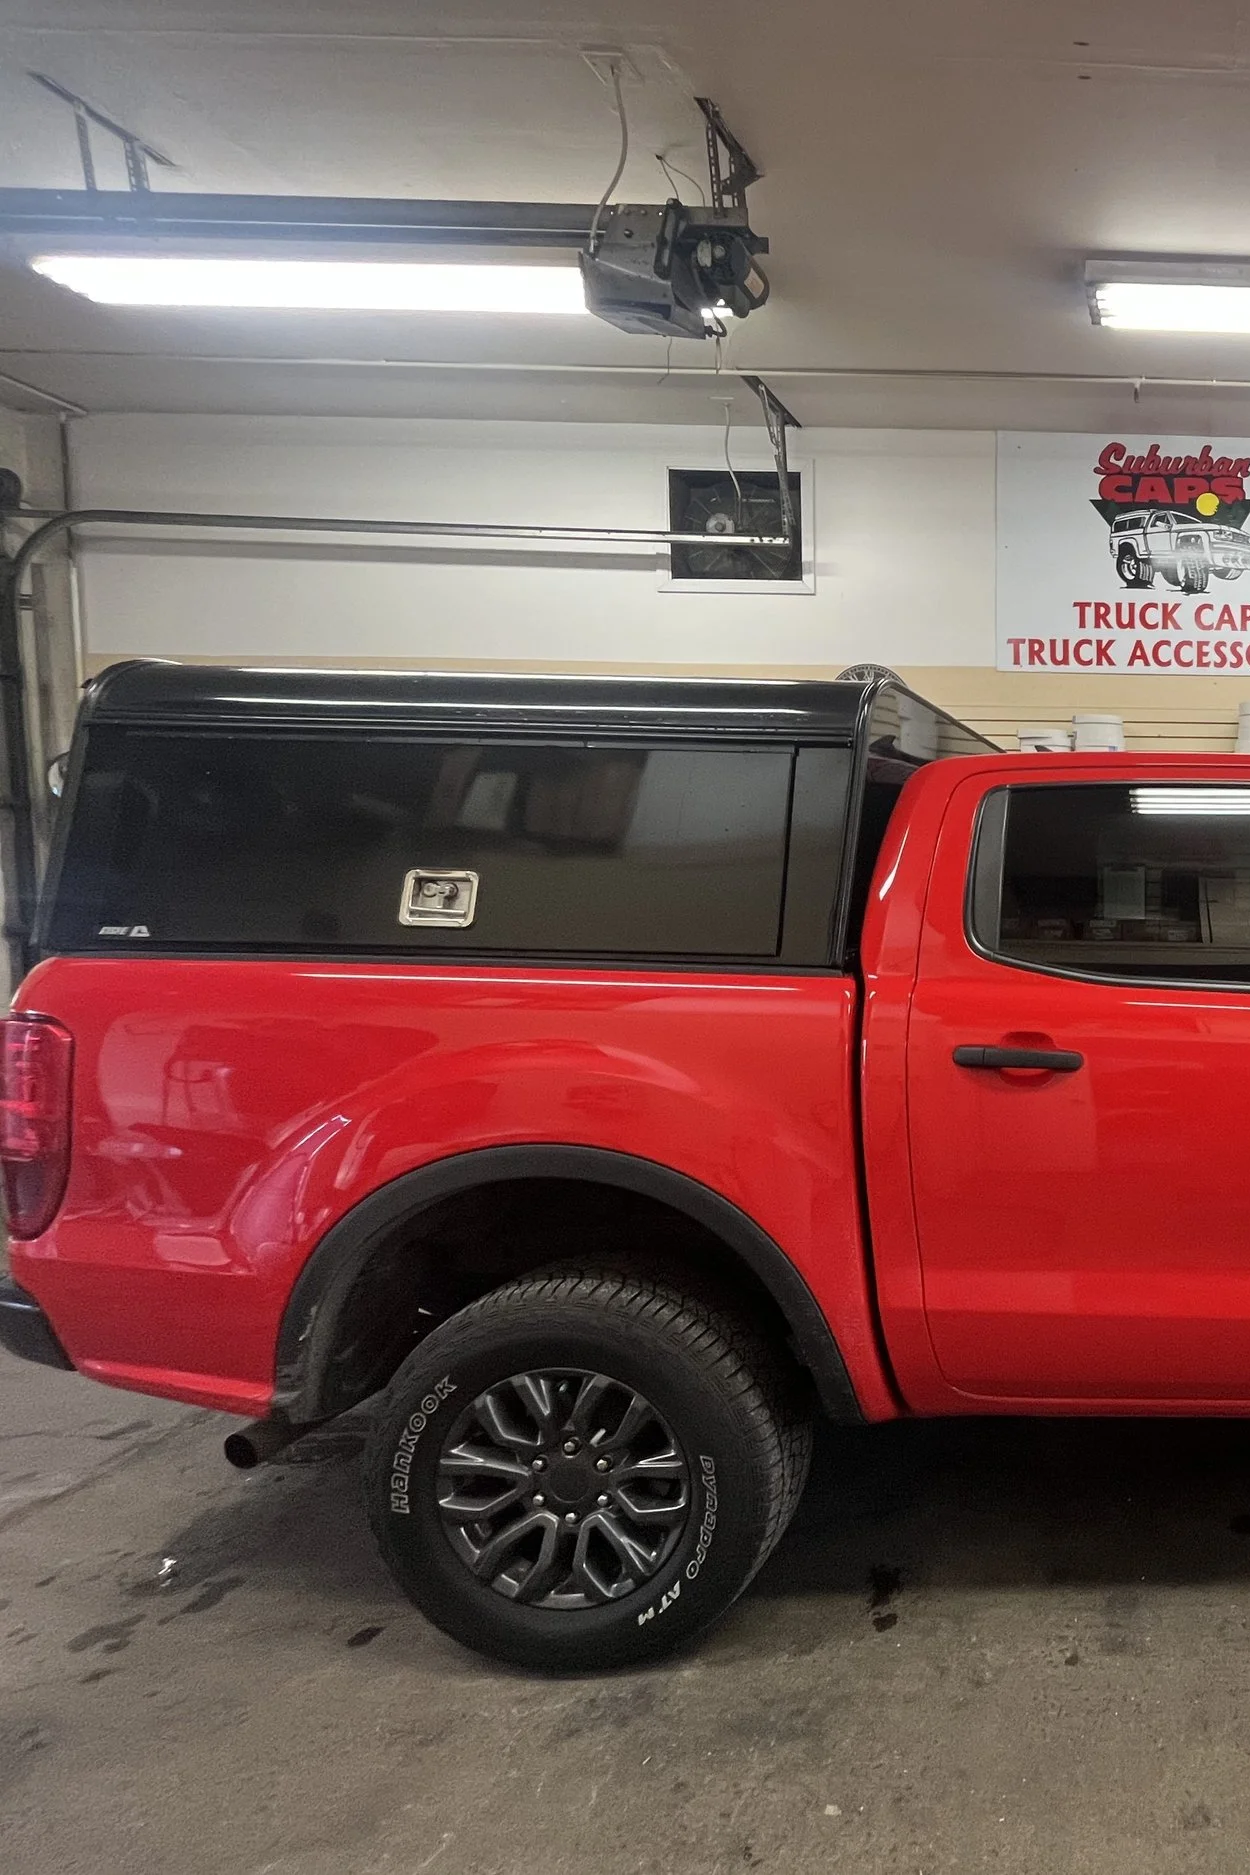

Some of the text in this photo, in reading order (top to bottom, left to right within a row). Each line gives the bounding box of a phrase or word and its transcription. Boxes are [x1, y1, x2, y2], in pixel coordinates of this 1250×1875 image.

[1099, 475, 1246, 504] CAPS
[1073, 602, 1182, 630] TRUCK
[1007, 638, 1117, 667] TRUCK
